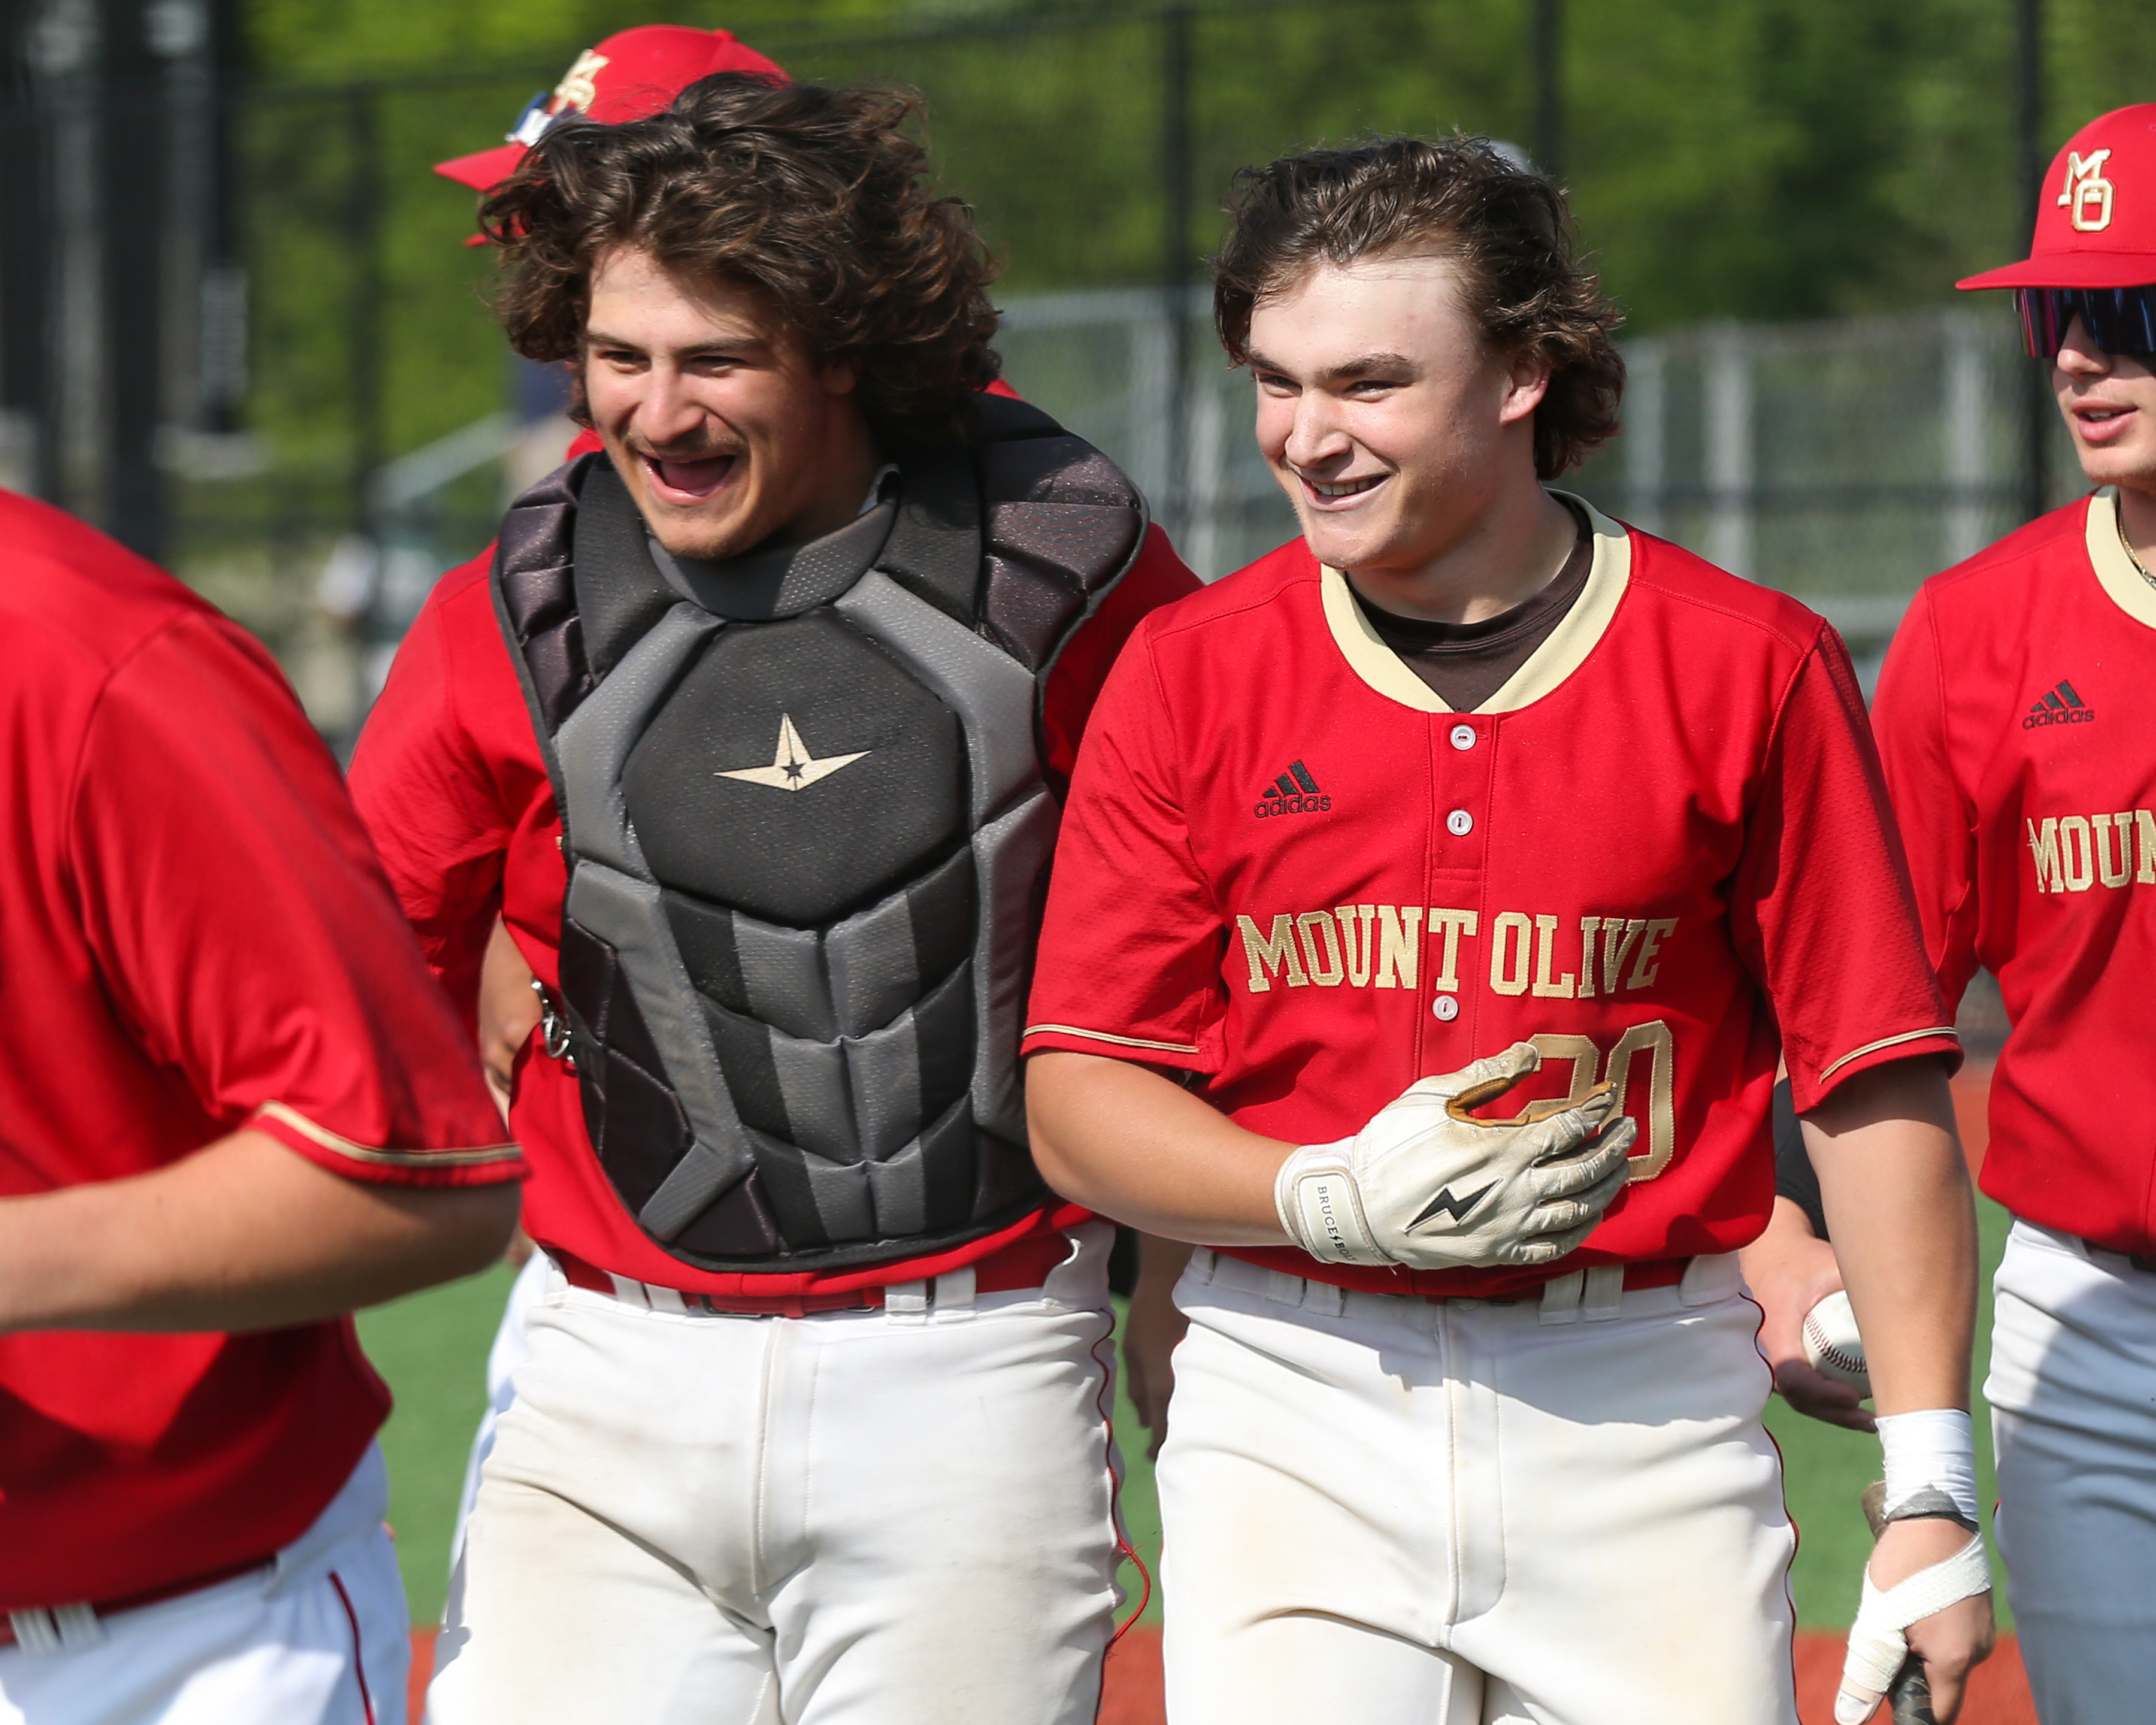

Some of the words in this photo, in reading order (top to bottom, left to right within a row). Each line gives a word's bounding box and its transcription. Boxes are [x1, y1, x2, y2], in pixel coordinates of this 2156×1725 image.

[2057, 148, 2115, 232] MO
[2022, 707, 2095, 730] adidas
[1255, 793, 1331, 818] adidas
[1237, 904, 1479, 992] MOUNT
[1489, 911, 1679, 999] OLIVE
